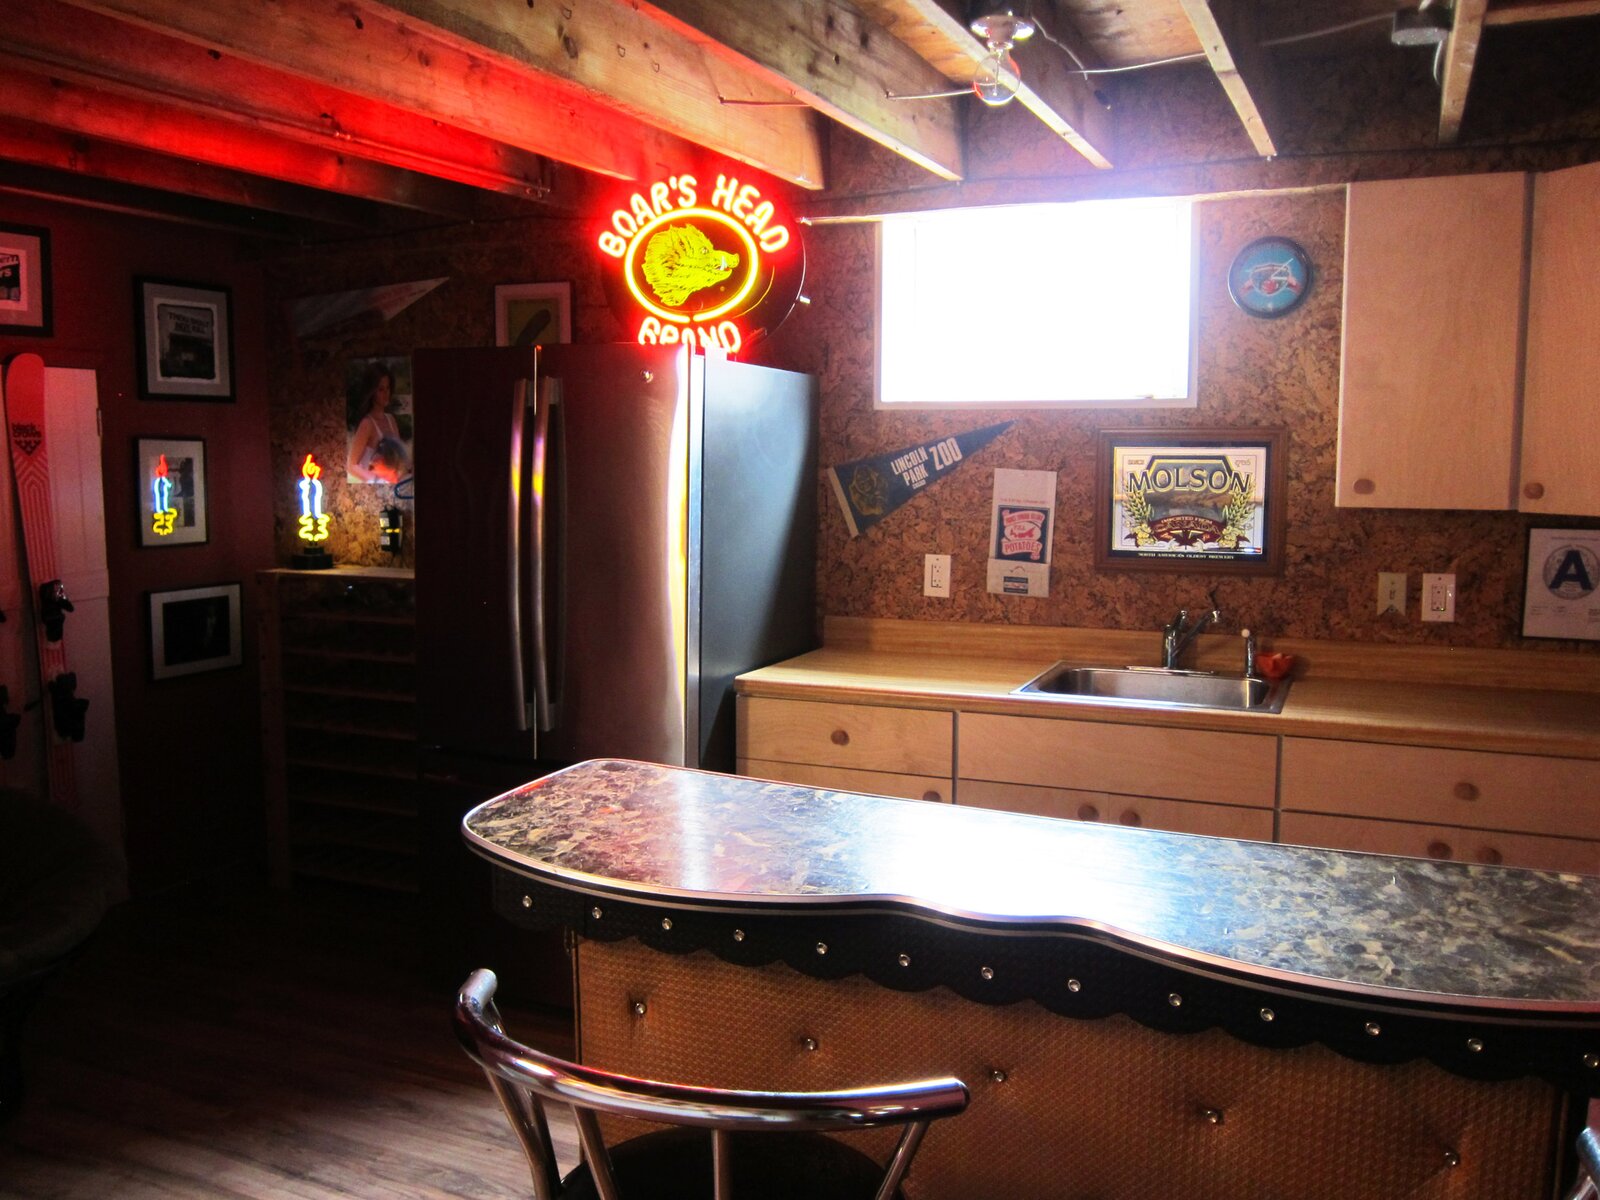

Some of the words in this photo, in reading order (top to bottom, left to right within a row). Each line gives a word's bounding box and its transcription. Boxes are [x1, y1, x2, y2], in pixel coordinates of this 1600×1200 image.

[598, 174, 698, 258] BOAR'S
[711, 173, 790, 253] HEAD
[890, 446, 928, 475] LINCOLN
[929, 437, 963, 471] ZOO
[902, 463, 929, 486] PARK
[1127, 467, 1251, 494] MOLSON
[1004, 539, 1041, 553] POTATOES
[1549, 549, 1594, 591] A
